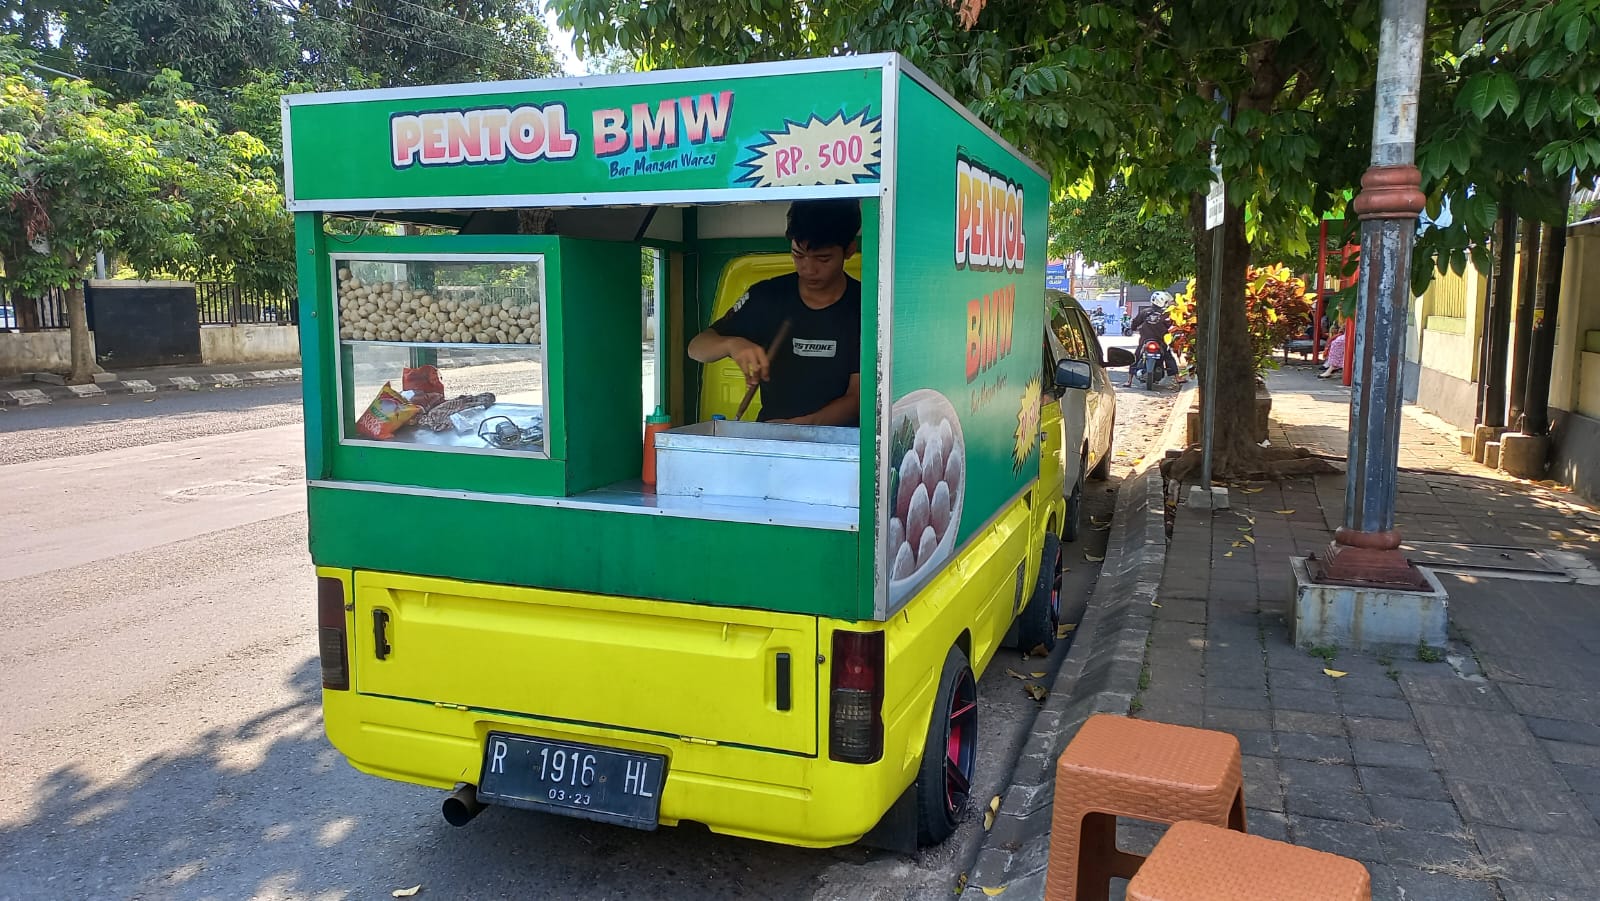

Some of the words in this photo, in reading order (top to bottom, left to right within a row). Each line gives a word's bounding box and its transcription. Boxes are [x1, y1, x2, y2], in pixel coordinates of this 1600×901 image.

[393, 103, 577, 167] PENTOL
[592, 90, 735, 157] BMW
[774, 144, 810, 179] RP.
[818, 135, 863, 169] 500
[609, 160, 631, 178] Bar
[634, 156, 678, 175] Mangan
[956, 158, 1026, 271] PENTOL
[966, 284, 1016, 384] BMW
[490, 741, 508, 774] R
[540, 748, 597, 786] 1916
[623, 760, 653, 798] HL
